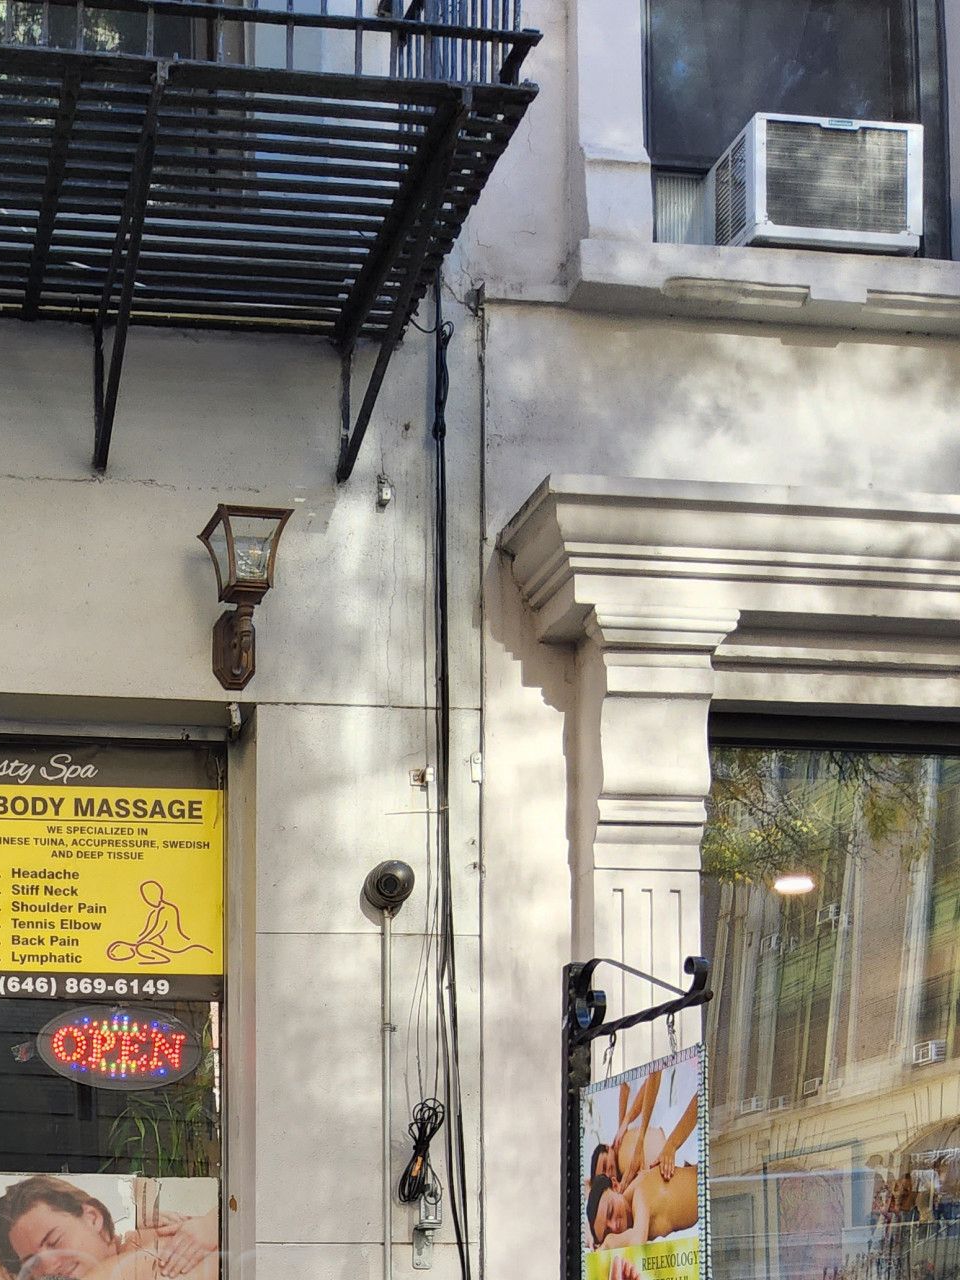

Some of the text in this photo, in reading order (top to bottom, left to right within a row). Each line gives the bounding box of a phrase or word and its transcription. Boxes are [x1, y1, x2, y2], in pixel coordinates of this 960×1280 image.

[40, 753, 99, 784] Spa
[73, 797, 203, 820] MASSAGE
[47, 825, 148, 836] WE SPECIALIZED IN
[33, 838, 68, 848] TUINA,
[71, 838, 159, 849] ACCUPRESSURE,
[162, 840, 210, 850] SWEDISH
[51, 850, 144, 860] AND DEEP TISSUE
[11, 868, 79, 880] Headache
[11, 884, 40, 896] Stiff
[44, 886, 78, 897] Neck
[11, 901, 73, 913] Shoulder
[78, 902, 107, 914] Pain
[11, 918, 55, 930] Tennis
[60, 918, 101, 930] Elbow
[11, 934, 46, 946] Back
[50, 935, 79, 947] Pain
[11, 952, 82, 965] Lymphatic
[65, 978, 169, 995] 869-6149
[52, 1025, 186, 1071] OPEN
[642, 1250, 700, 1271] REFLEXOLOGY
